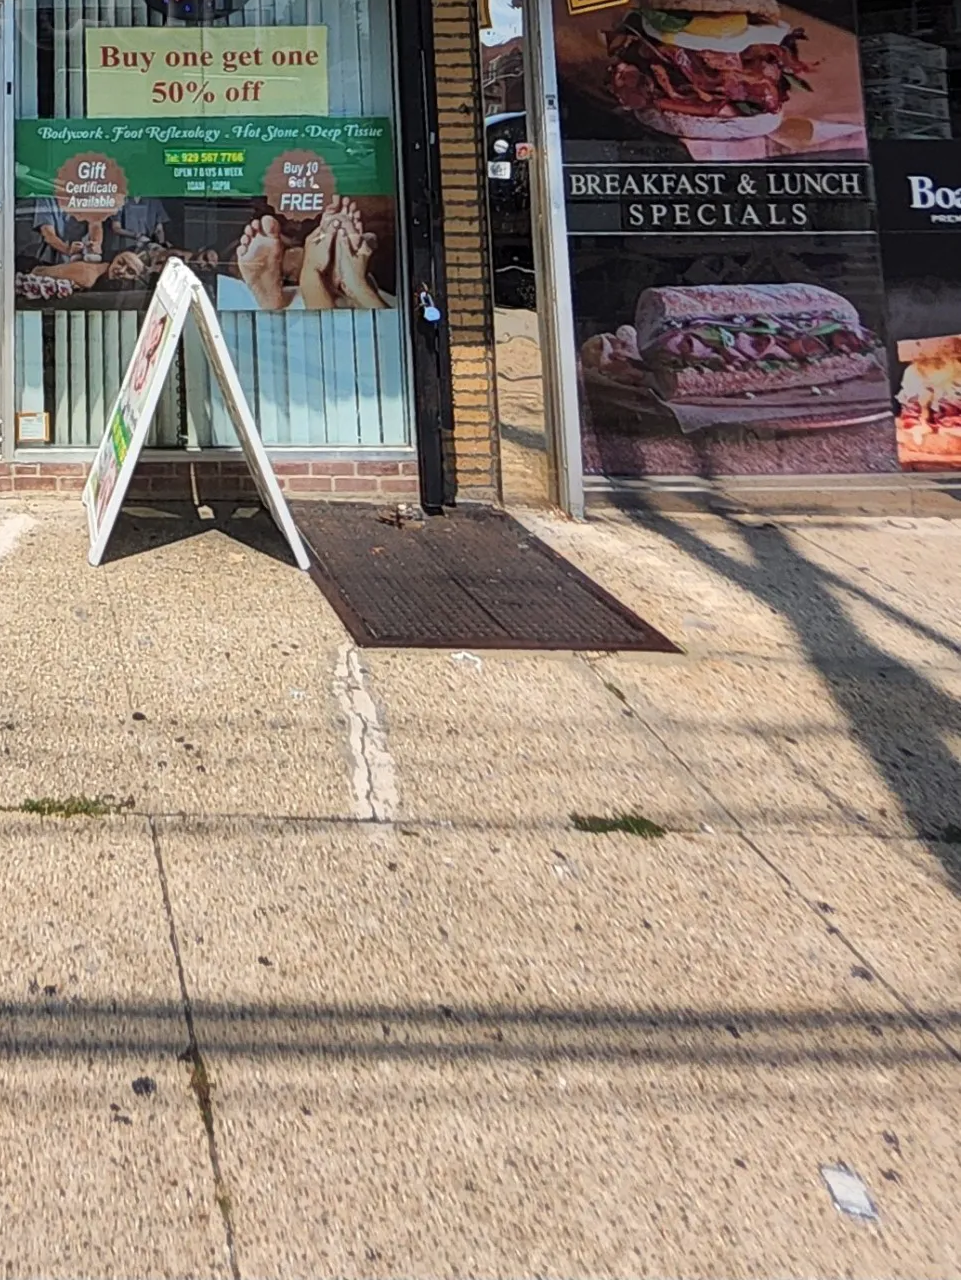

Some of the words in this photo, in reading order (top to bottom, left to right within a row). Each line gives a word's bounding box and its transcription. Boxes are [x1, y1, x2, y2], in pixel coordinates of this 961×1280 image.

[100, 45, 156, 73] Buy
[165, 49, 214, 67] one
[222, 47, 263, 73] get
[272, 49, 319, 67] one
[152, 80, 215, 104] 50%
[225, 80, 265, 103] off
[38, 126, 104, 143] Bodywork
[111, 125, 143, 142] Foot
[145, 125, 221, 142] Reflexology
[232, 123, 261, 138] Hot
[261, 125, 299, 141] Stone
[305, 124, 342, 141] Deep
[343, 124, 383, 137] Tissue
[77, 161, 107, 179] Gift
[283, 161, 304, 176] Buy
[306, 161, 319, 173] 10
[65, 181, 118, 194] Certificate
[288, 176, 307, 189] Get
[569, 173, 726, 195] BREAKFAST
[737, 173, 758, 195] &
[766, 173, 863, 195] LUNCH
[67, 196, 116, 209] Available
[279, 193, 324, 211] FREE
[629, 203, 808, 226] SPECIALS
